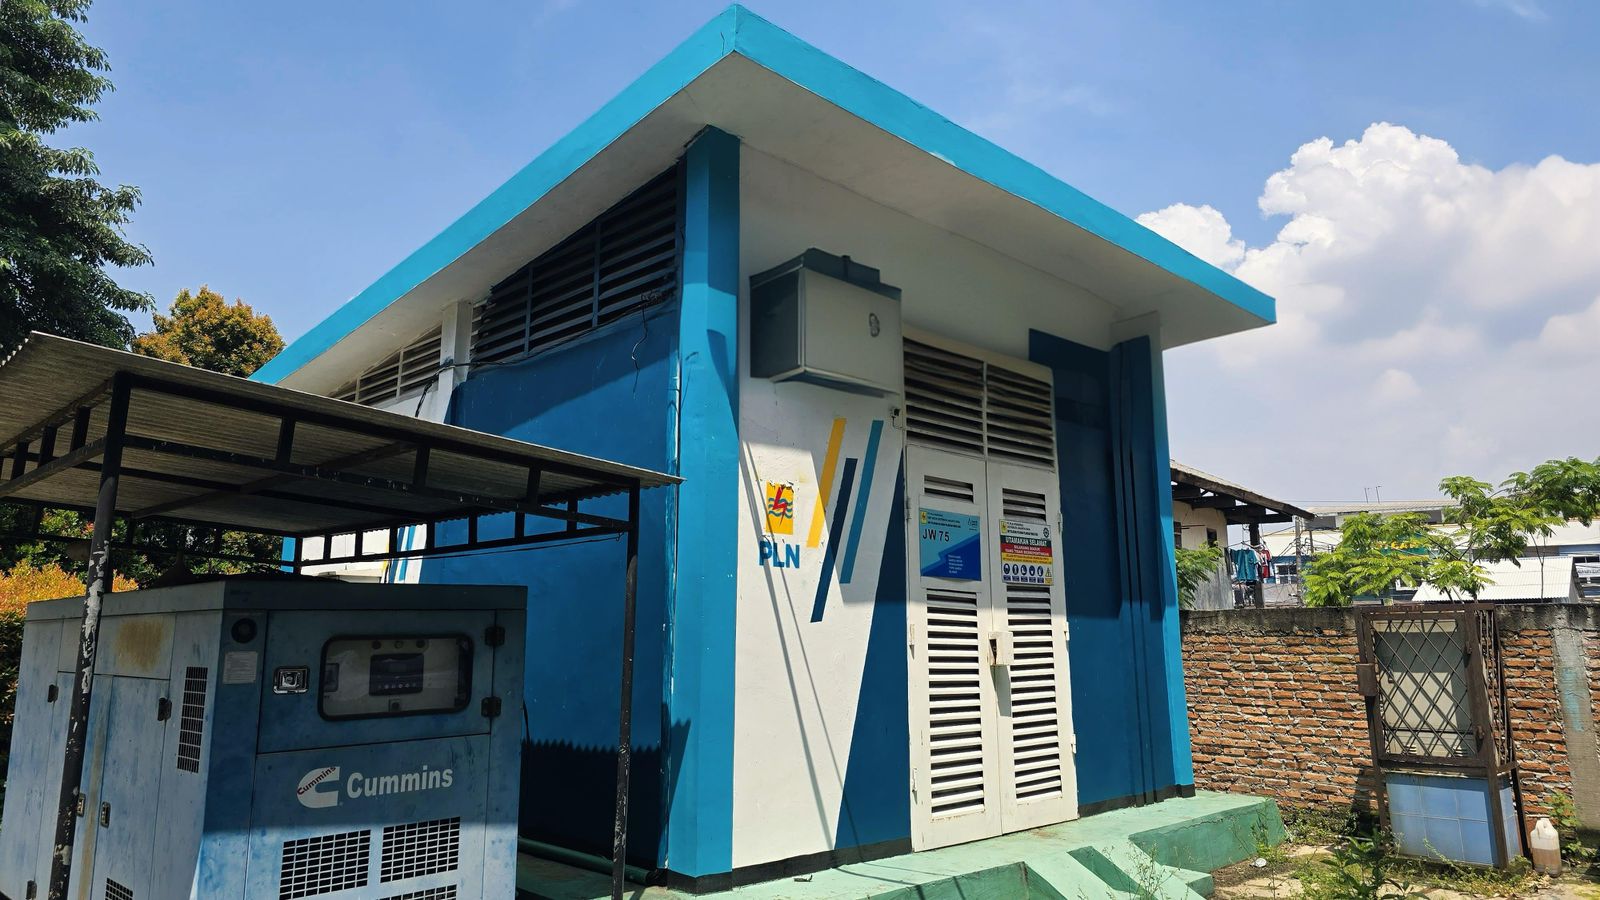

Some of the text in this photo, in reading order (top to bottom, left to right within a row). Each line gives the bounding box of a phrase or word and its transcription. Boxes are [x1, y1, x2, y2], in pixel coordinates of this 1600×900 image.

[922, 528, 950, 542] JW 75
[759, 540, 800, 569] PLN
[297, 767, 336, 795] Cummins
[346, 765, 453, 799] Cummins
